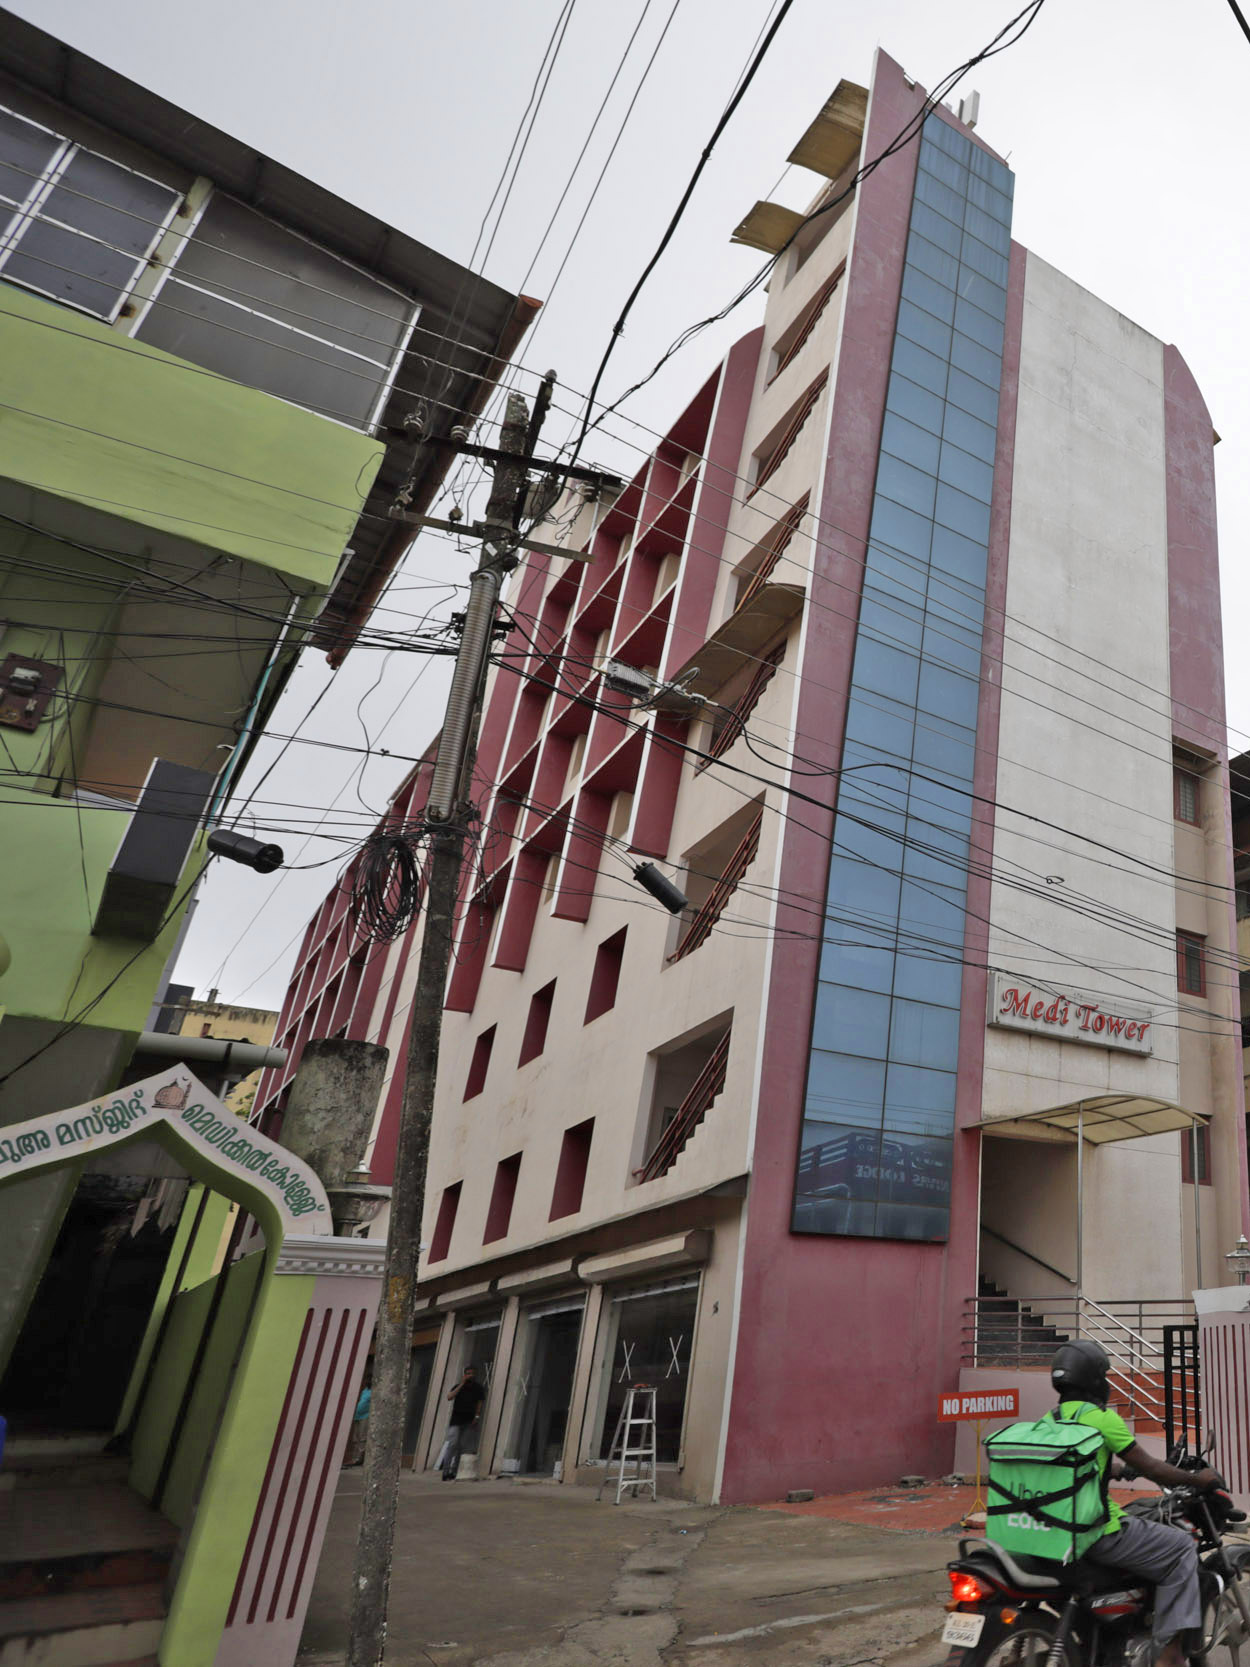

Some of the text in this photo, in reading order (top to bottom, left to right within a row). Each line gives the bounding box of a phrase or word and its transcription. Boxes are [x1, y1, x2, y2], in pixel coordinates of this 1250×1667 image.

[1000, 988, 1151, 1041] Medi Tower
[942, 1395, 1015, 1415] NO PARKING
